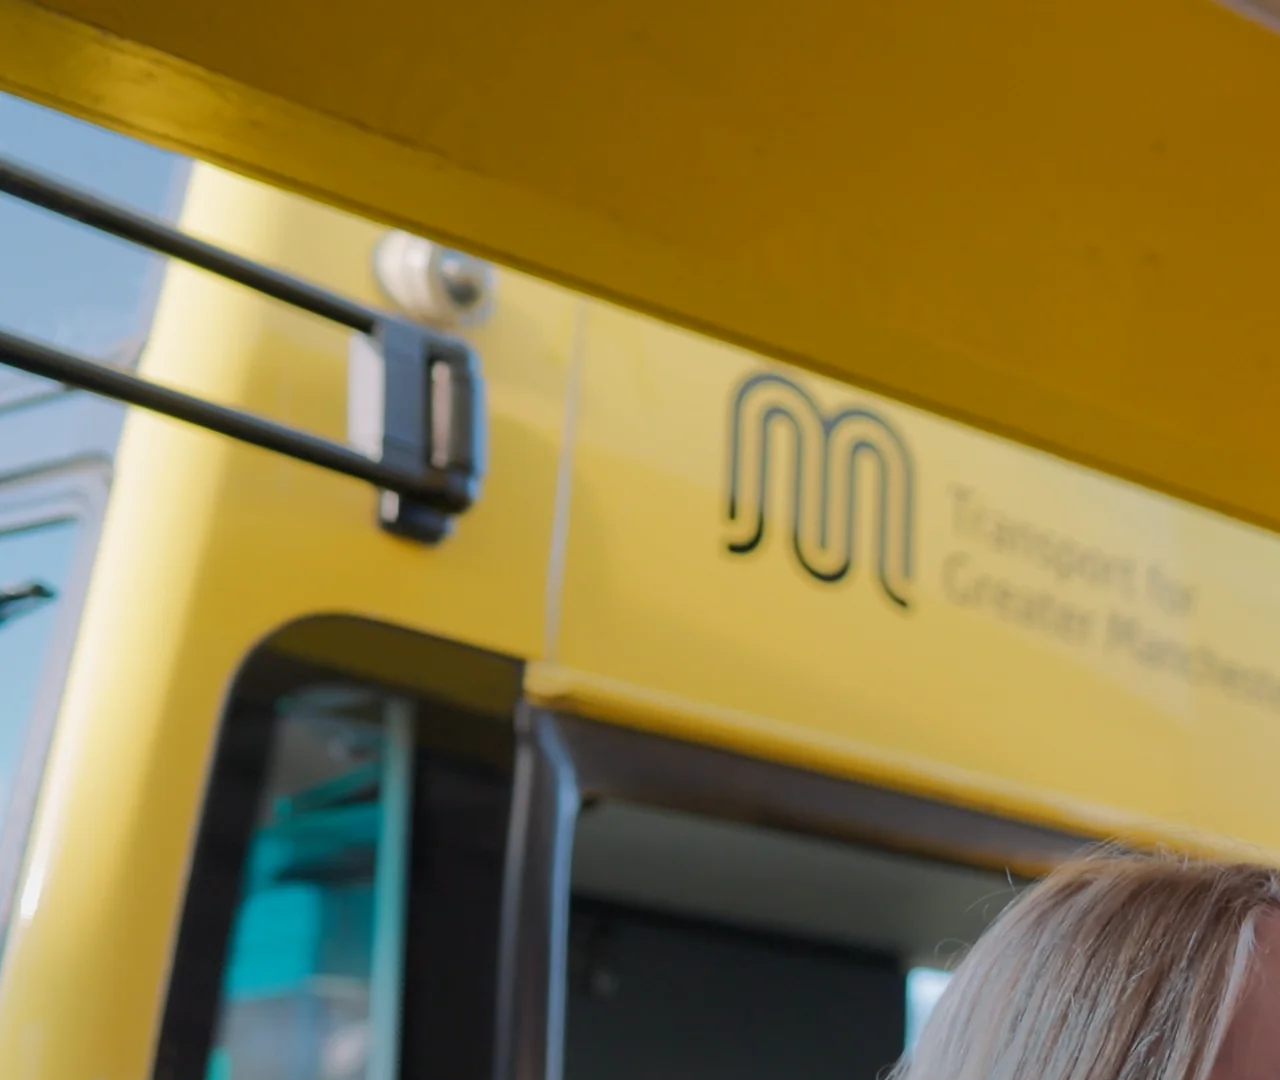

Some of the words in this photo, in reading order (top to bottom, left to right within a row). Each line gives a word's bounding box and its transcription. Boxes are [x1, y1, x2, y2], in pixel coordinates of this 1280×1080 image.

[940, 550, 1091, 647] Greater
[948, 485, 1137, 599] Transport
[1146, 559, 1200, 616] for
